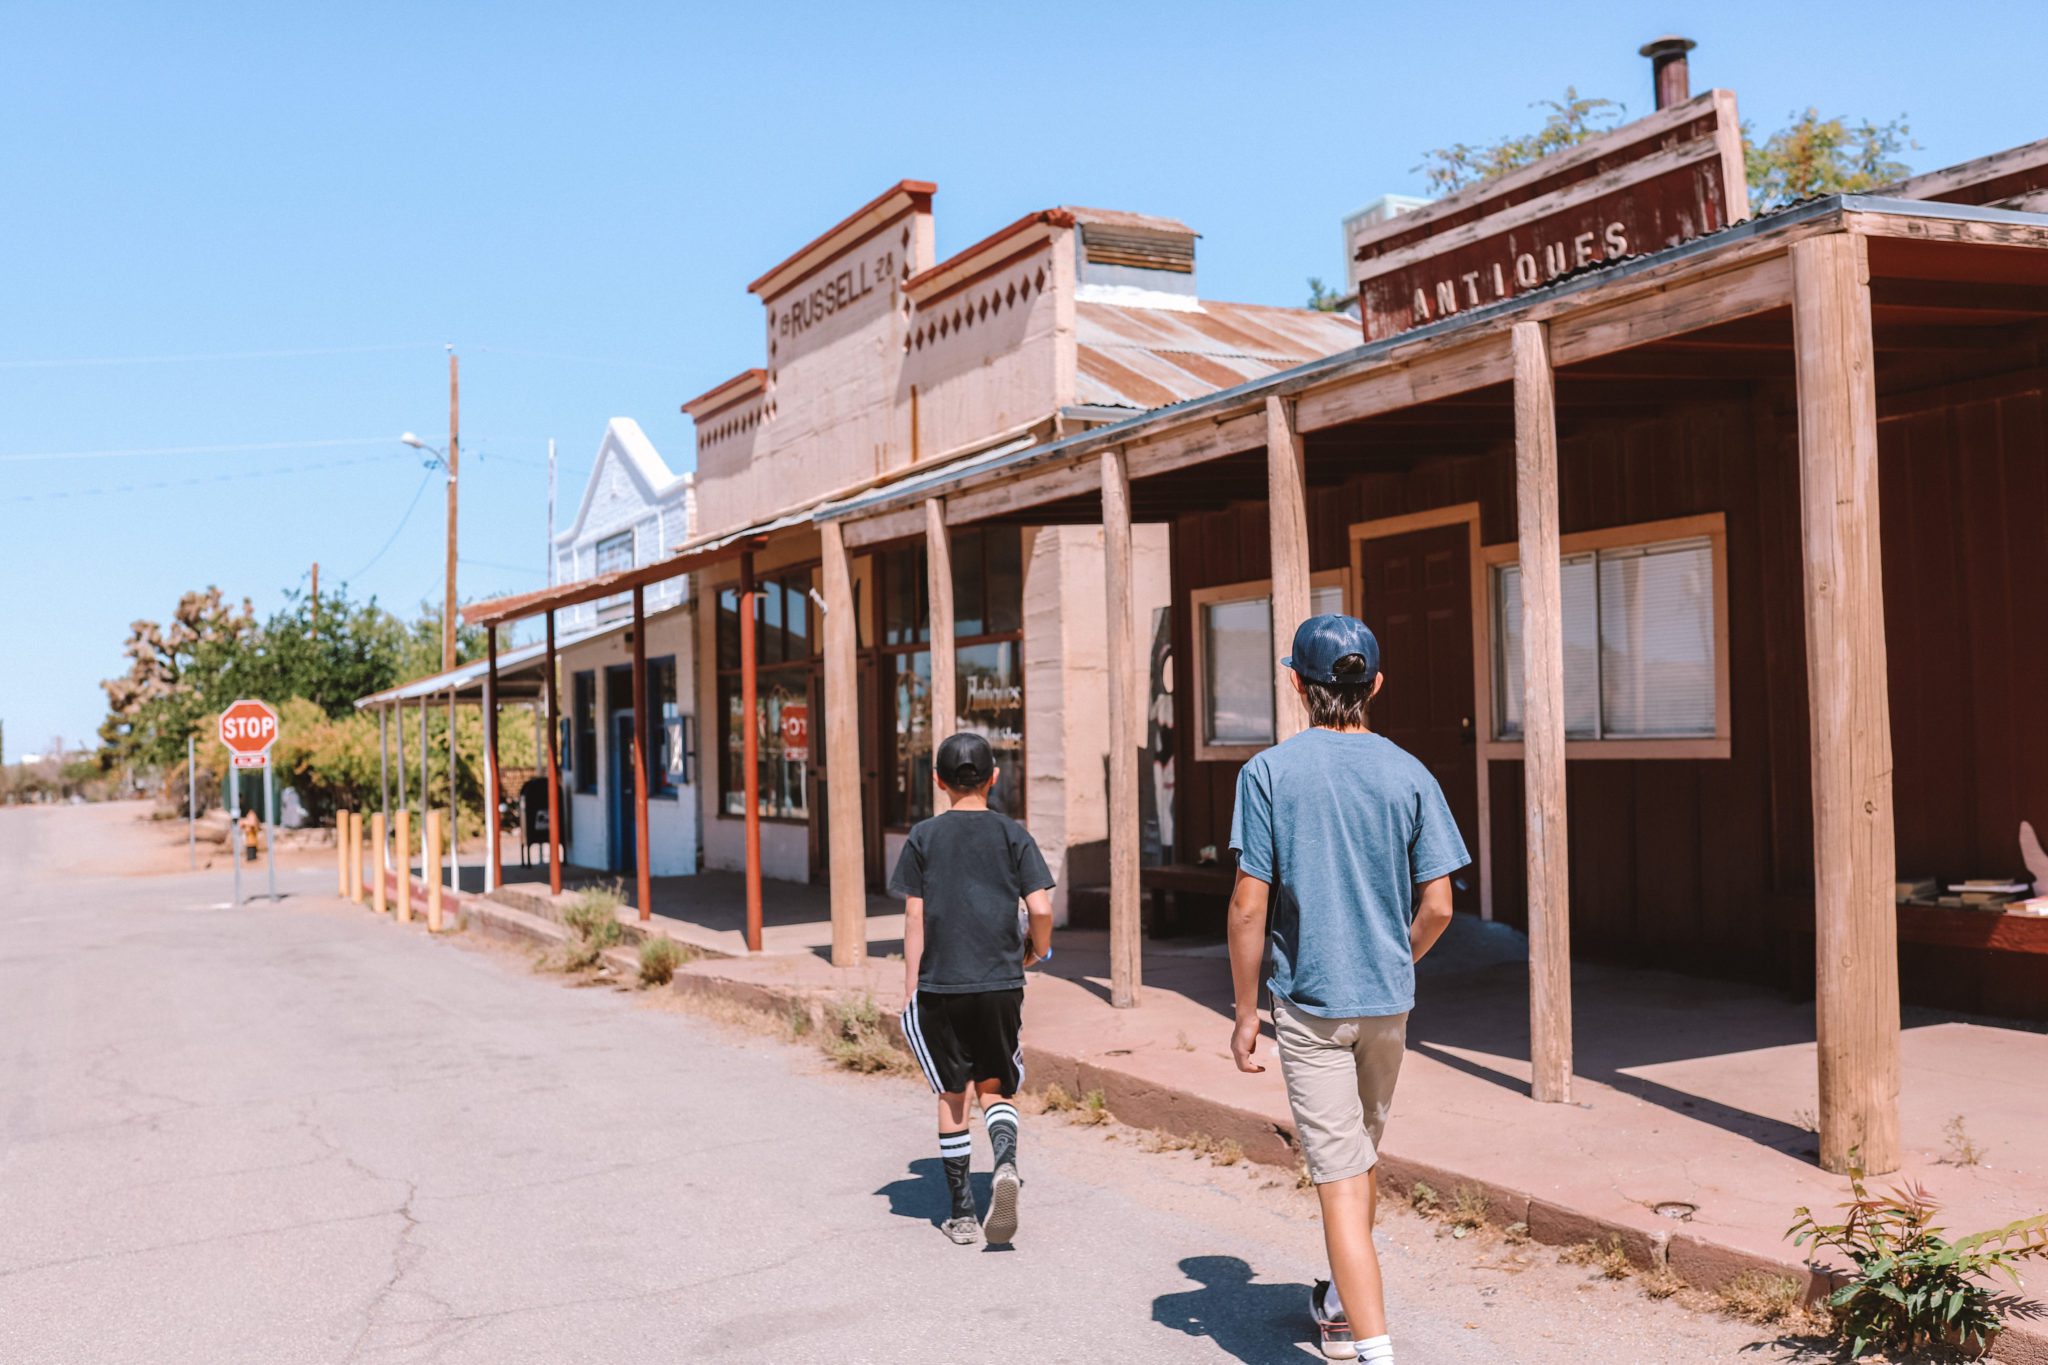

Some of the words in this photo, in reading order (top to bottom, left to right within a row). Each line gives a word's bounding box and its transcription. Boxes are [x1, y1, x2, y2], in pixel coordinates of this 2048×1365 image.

[791, 262, 873, 338] RUSSELL
[1412, 220, 1628, 322] ANTIQUES
[224, 716, 274, 739] STOP
